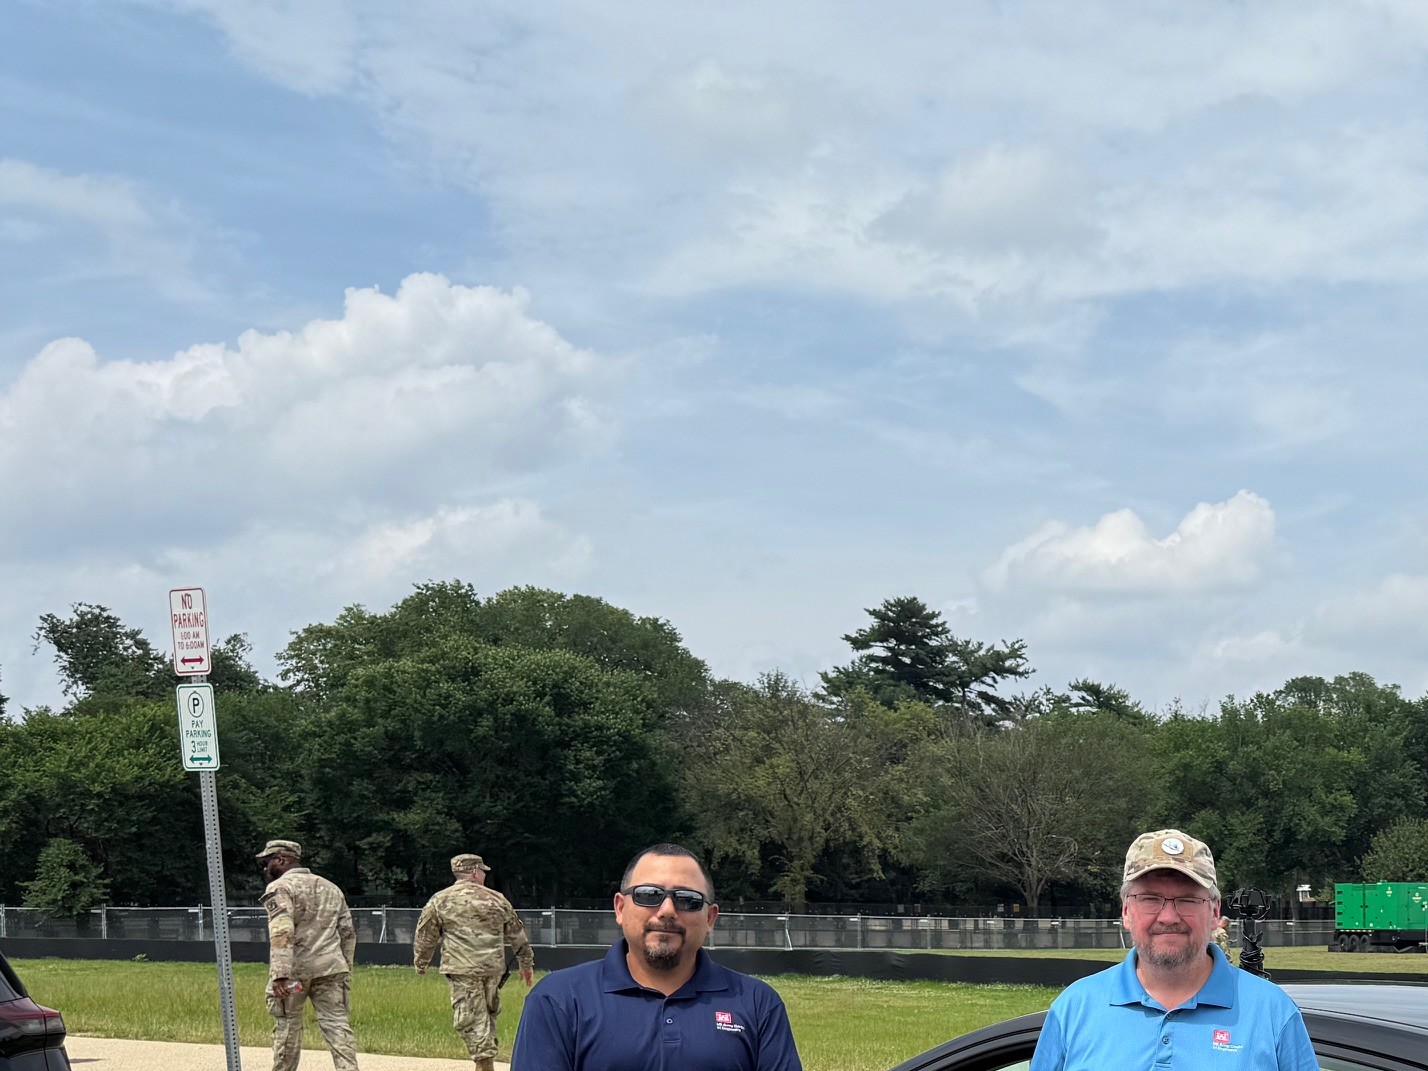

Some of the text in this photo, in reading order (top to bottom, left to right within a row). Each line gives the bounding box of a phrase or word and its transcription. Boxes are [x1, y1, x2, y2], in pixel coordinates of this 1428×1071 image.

[181, 593, 192, 609] NO
[173, 612, 204, 629] PARKING
[192, 631, 200, 639] AM
[178, 642, 184, 650] TO
[192, 698, 200, 714] P
[191, 720, 203, 728] PAY
[186, 730, 211, 738] PARKING
[191, 741, 196, 753] 3
